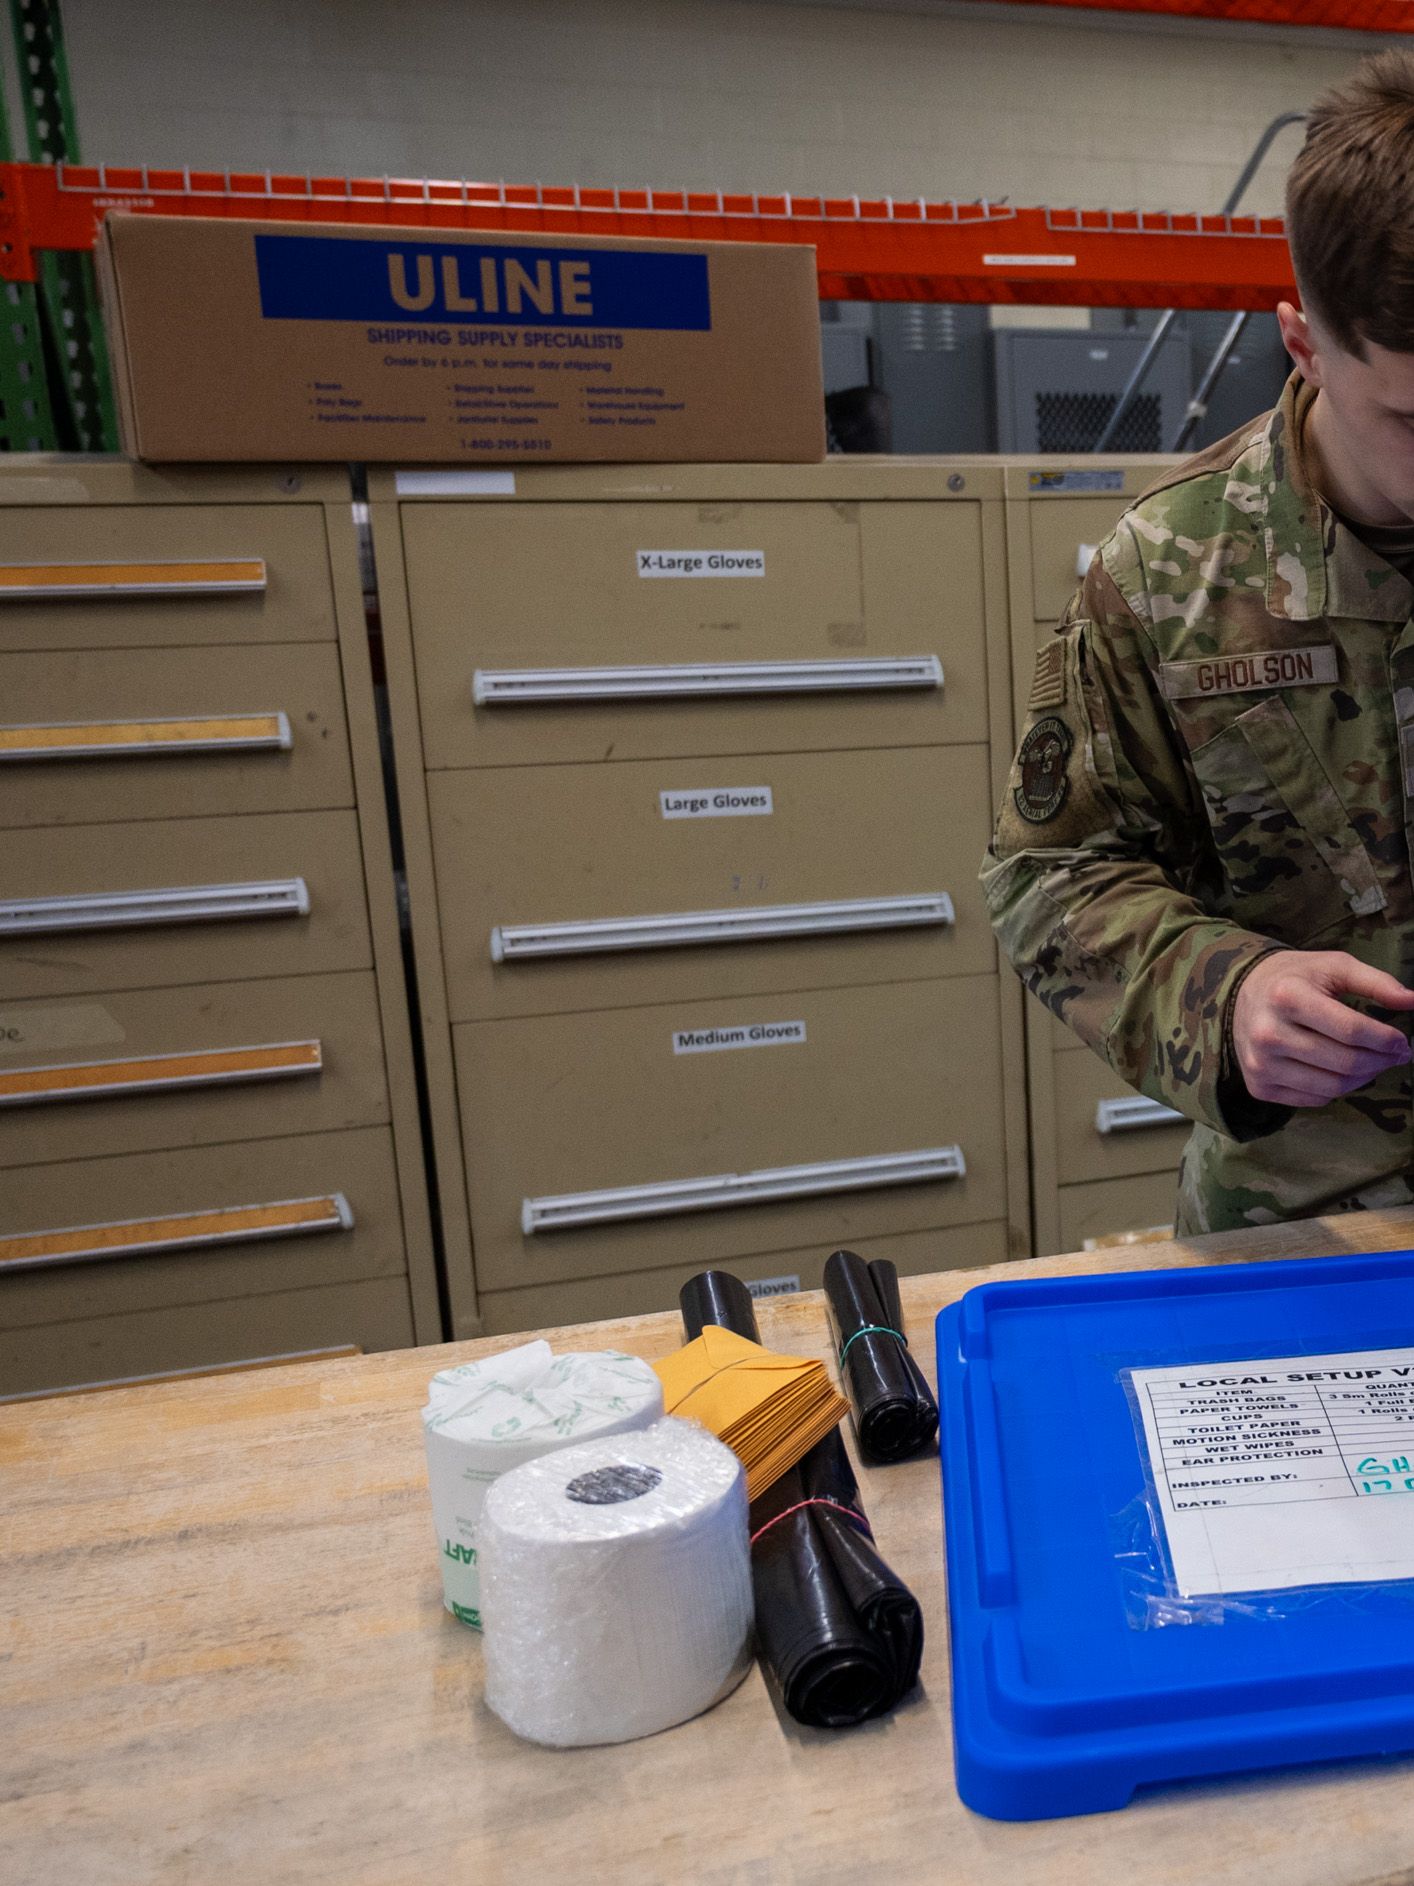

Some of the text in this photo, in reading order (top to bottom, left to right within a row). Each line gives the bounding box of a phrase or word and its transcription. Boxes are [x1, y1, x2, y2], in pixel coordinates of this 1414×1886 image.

[387, 253, 594, 317] ULINE
[367, 328, 624, 349] SHIPPING SUPPLY SPECIALISTS
[383, 355, 419, 368] Order
[422, 356, 438, 369] by
[482, 357, 499, 369] for
[502, 360, 535, 370] same
[538, 359, 560, 372] day
[563, 359, 612, 373] shipping
[641, 554, 763, 572] X-Large Gloves
[1197, 653, 1314, 692] GHOLSON
[665, 793, 767, 813] Large Gloves
[678, 1025, 801, 1047] Medium Gloves
[749, 1282, 797, 1297] Gloves
[1179, 1376, 1278, 1389] LOCAL
[1286, 1370, 1382, 1382] SETUP
[1179, 1403, 1299, 1415] PAPER TOWELS
[1187, 1397, 1238, 1405] TRASH
[1221, 1413, 1263, 1421] CUPS
[1188, 1420, 1301, 1434] TOILET PAPER
[1172, 1429, 1322, 1446] MOTION SICKNESS
[1205, 1440, 1295, 1453] WET WIPES
[1181, 1448, 1323, 1466] EAR PROTECTION
[1171, 1473, 1298, 1489] INSPECTED BY:
[1362, 1480, 1392, 1493] 17
[1176, 1500, 1227, 1509] DATE:
